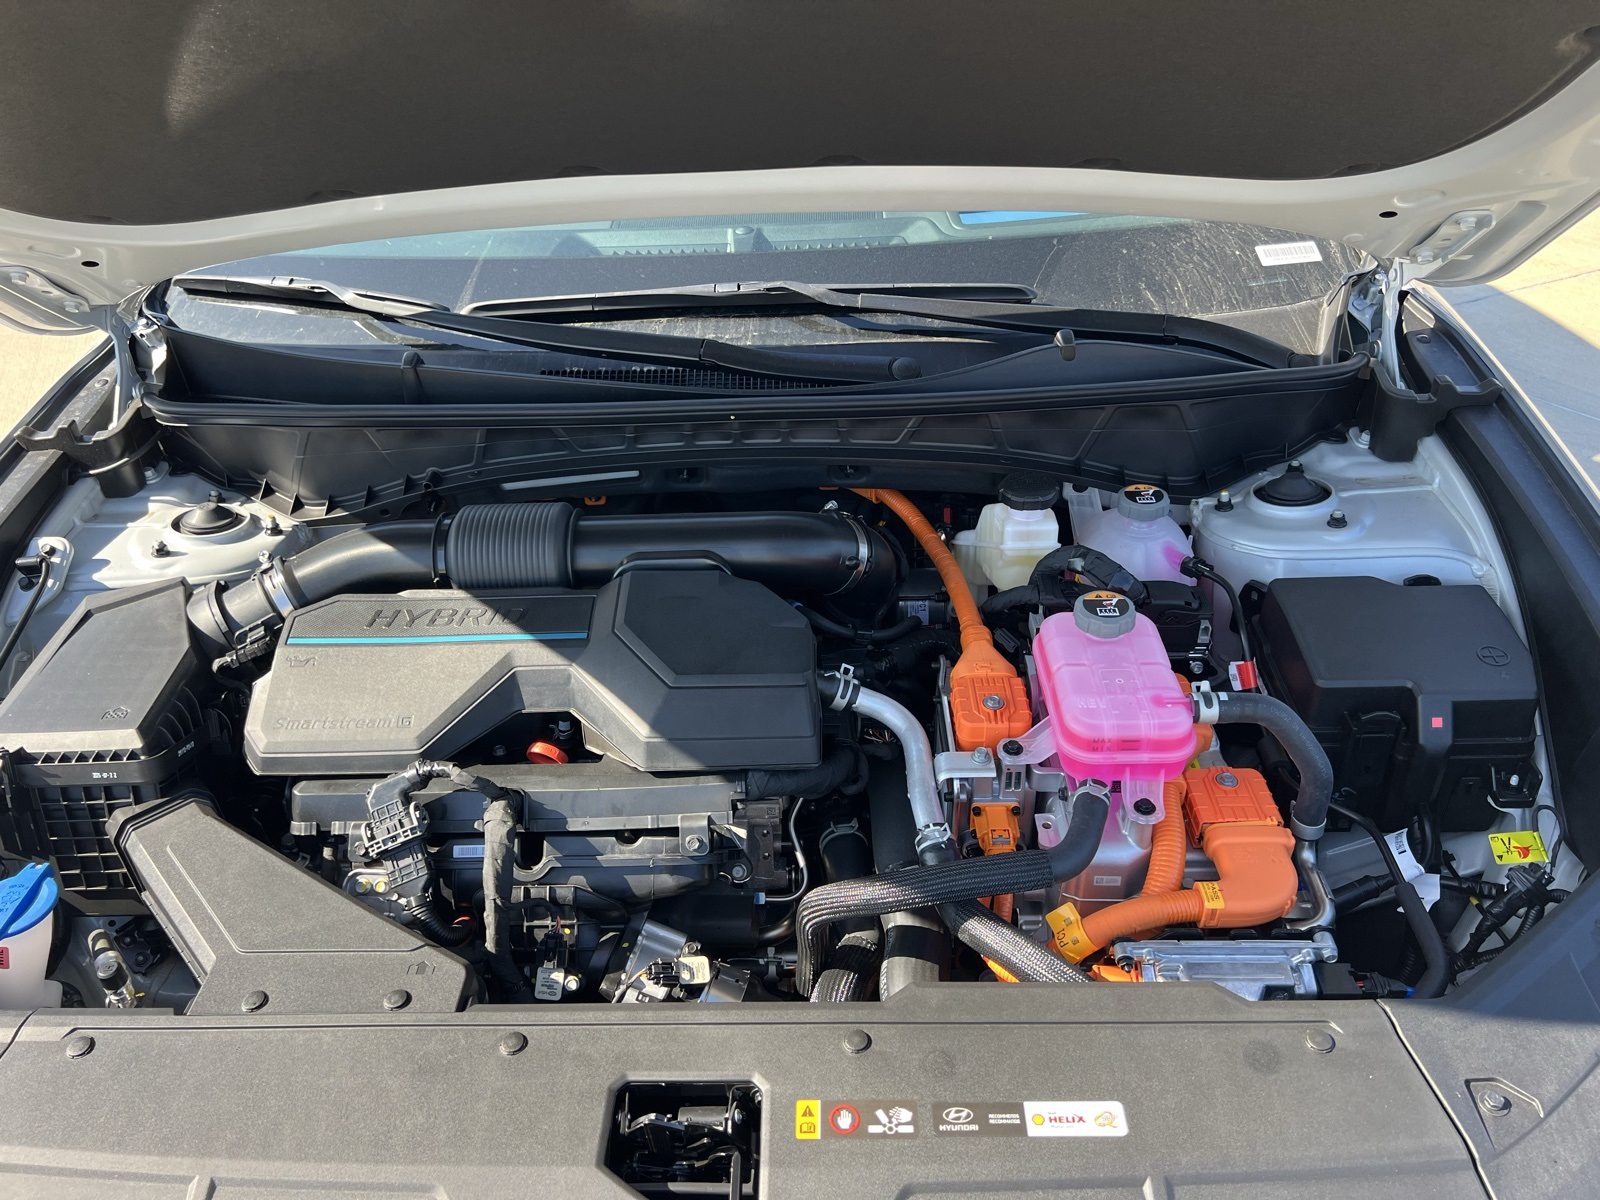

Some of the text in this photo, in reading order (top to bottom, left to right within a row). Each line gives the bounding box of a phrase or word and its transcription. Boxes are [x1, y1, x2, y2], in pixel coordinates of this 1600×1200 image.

[363, 607, 529, 629] HYBRID
[272, 716, 413, 730] Smartstream G
[1056, 927, 1070, 948] PC1
[1048, 1113, 1087, 1123] HELIX
